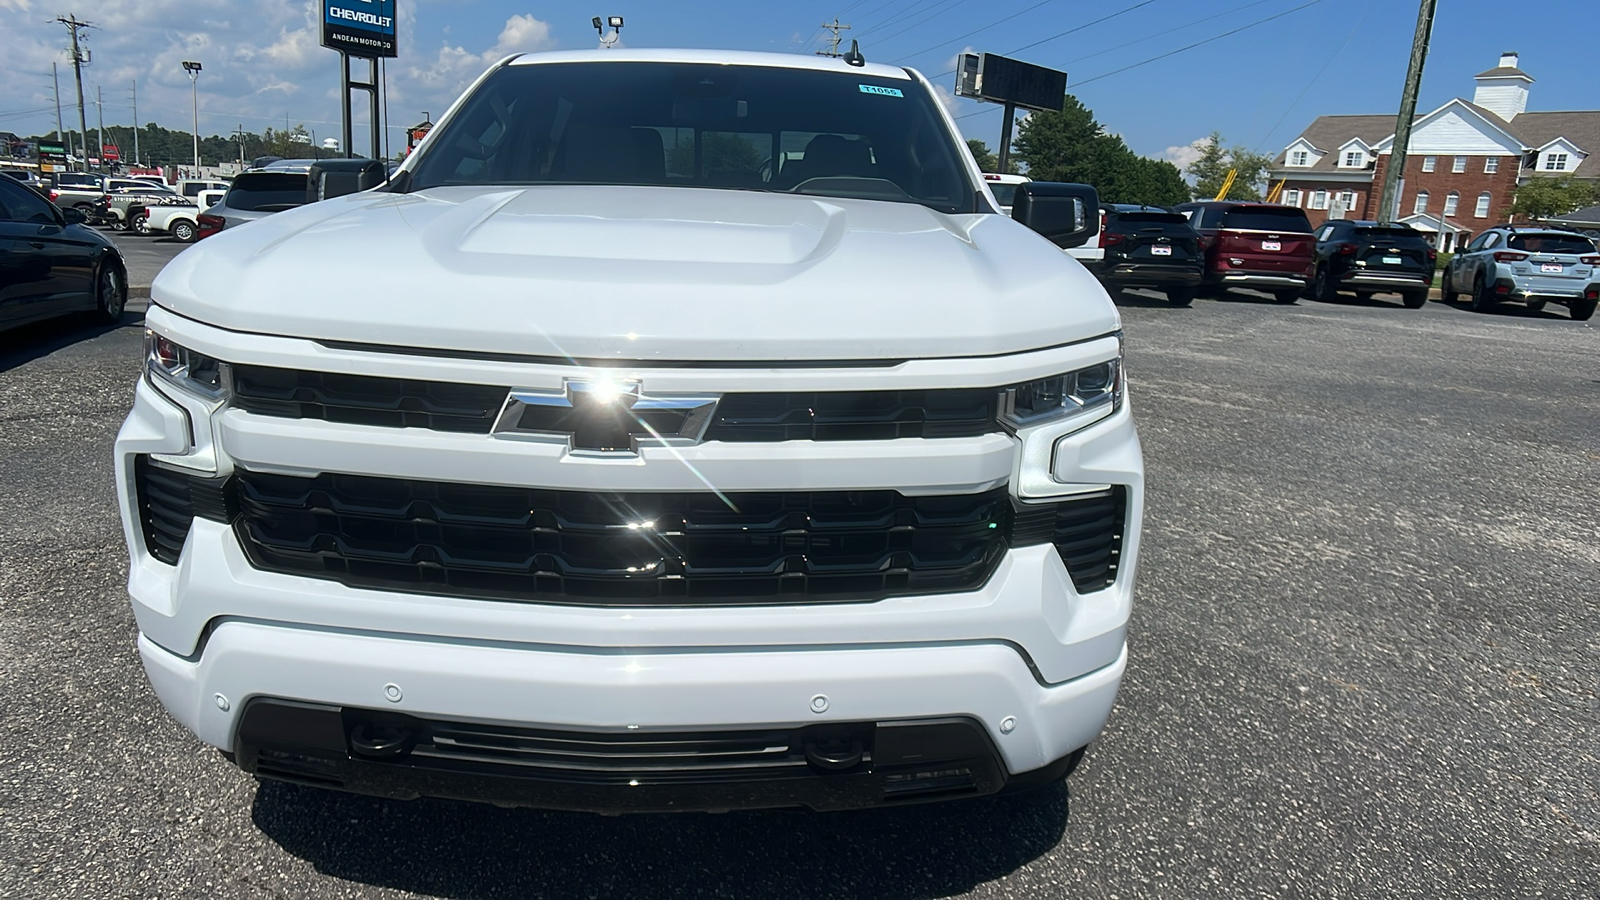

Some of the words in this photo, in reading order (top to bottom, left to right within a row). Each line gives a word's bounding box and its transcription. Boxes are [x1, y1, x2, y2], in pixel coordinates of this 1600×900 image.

[330, 6, 392, 28] CHEVROLET
[332, 33, 359, 43] ANDEAN
[359, 37, 382, 47] MOTOR
